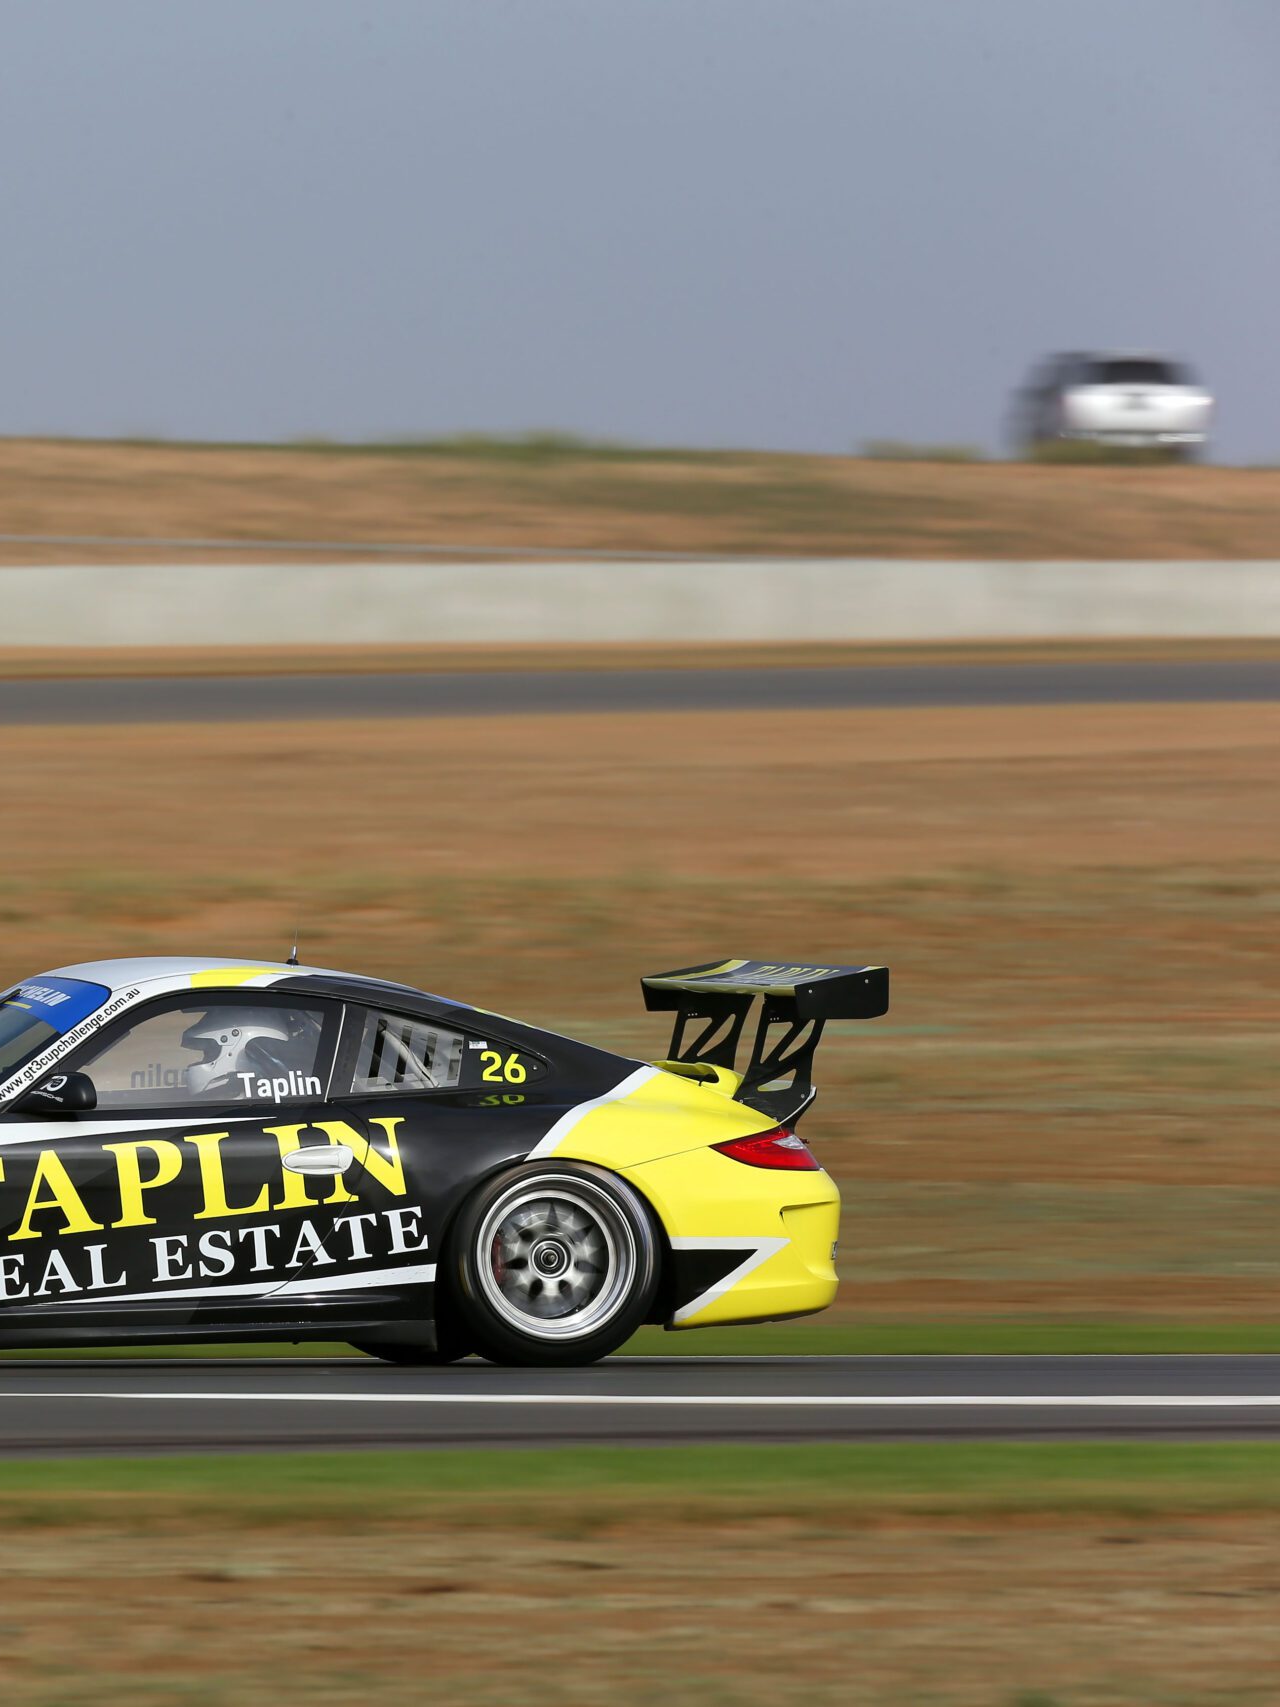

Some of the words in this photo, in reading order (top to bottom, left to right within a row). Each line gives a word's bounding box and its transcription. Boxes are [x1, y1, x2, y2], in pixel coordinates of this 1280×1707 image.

[19, 985, 73, 1007] CHELIN
[480, 1050, 527, 1084] 26
[236, 1070, 322, 1104] Taplin
[148, 1205, 430, 1284] ESTATE
